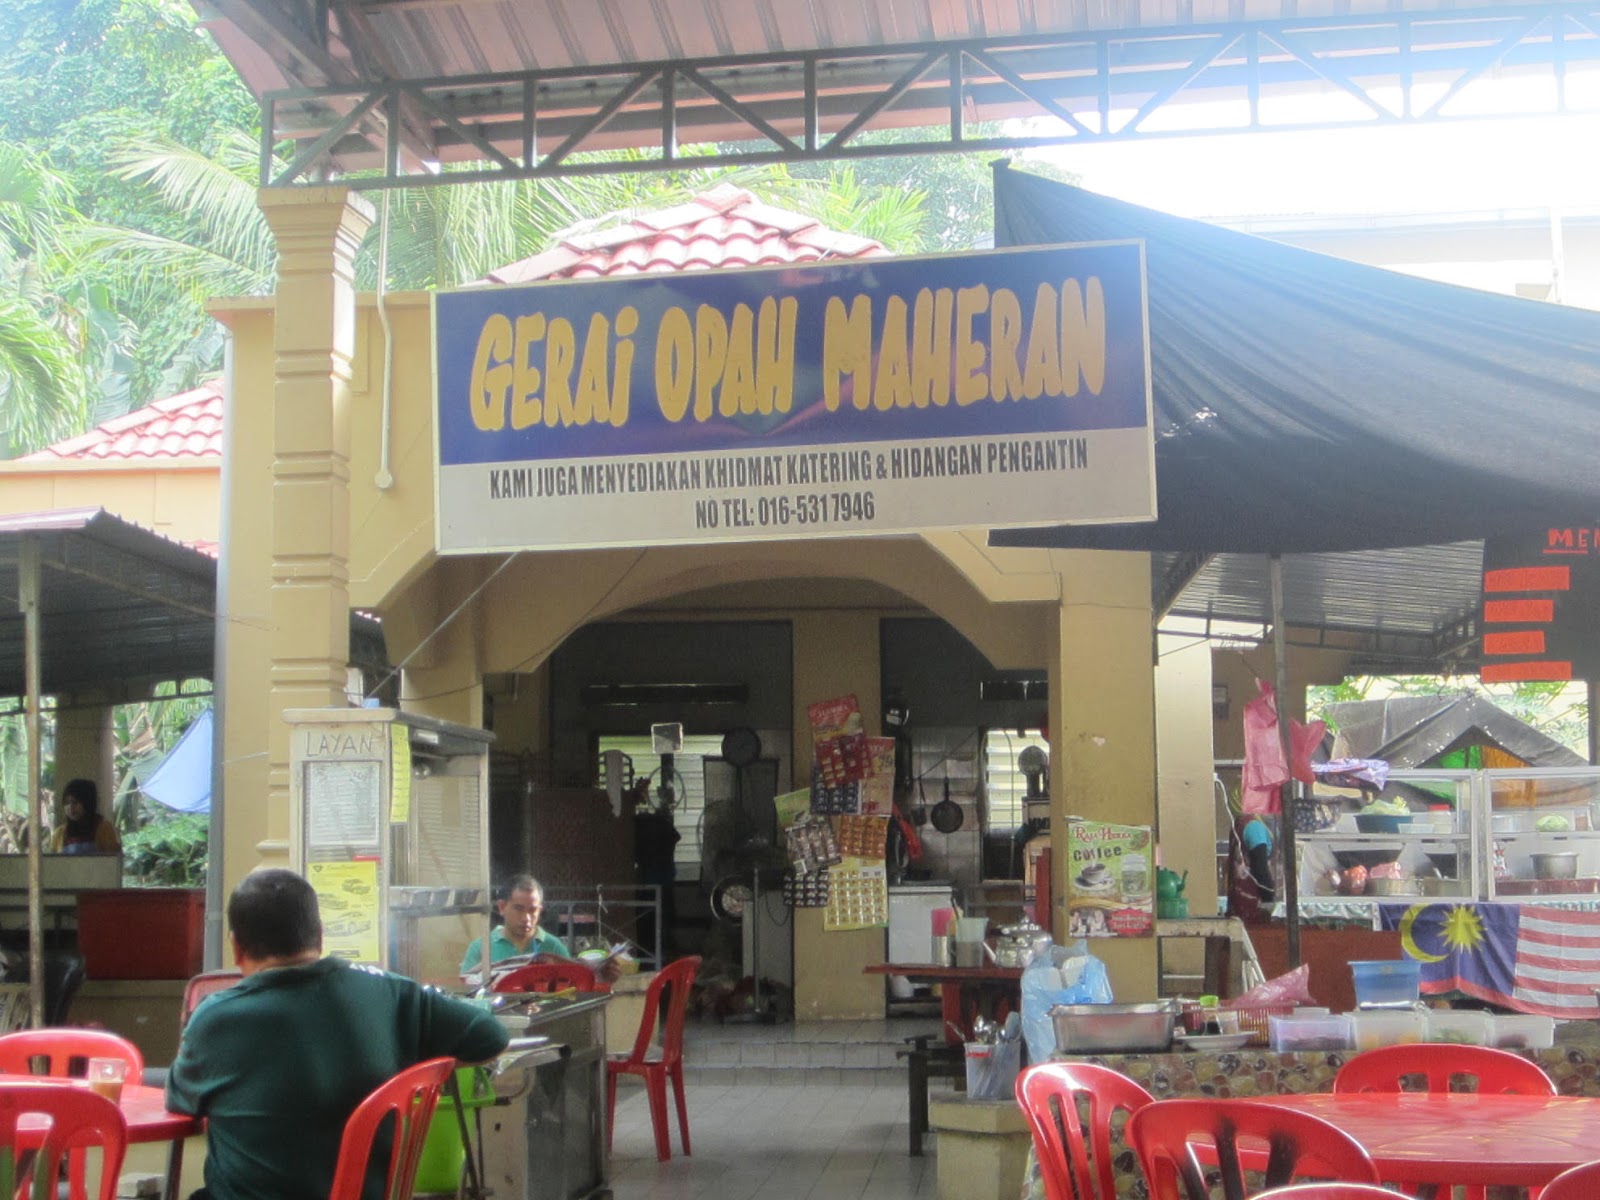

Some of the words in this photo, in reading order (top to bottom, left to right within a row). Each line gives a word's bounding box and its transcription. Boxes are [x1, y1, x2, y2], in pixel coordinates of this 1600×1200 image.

[654, 296, 798, 423] OPAH
[823, 276, 1106, 412] MAHERAN
[490, 468, 533, 500] KAMI
[536, 465, 578, 497] JUGA
[581, 460, 700, 494] MENYEDIAKAN
[705, 455, 783, 489] KHIDMAT
[787, 450, 871, 484] KATERING
[876, 453, 888, 480] &
[891, 443, 982, 479] HIDANGAN
[987, 438, 1088, 473] PENGANTIN
[695, 500, 718, 529] NO
[722, 497, 754, 527] TEL:
[305, 731, 373, 758] LAYAN
